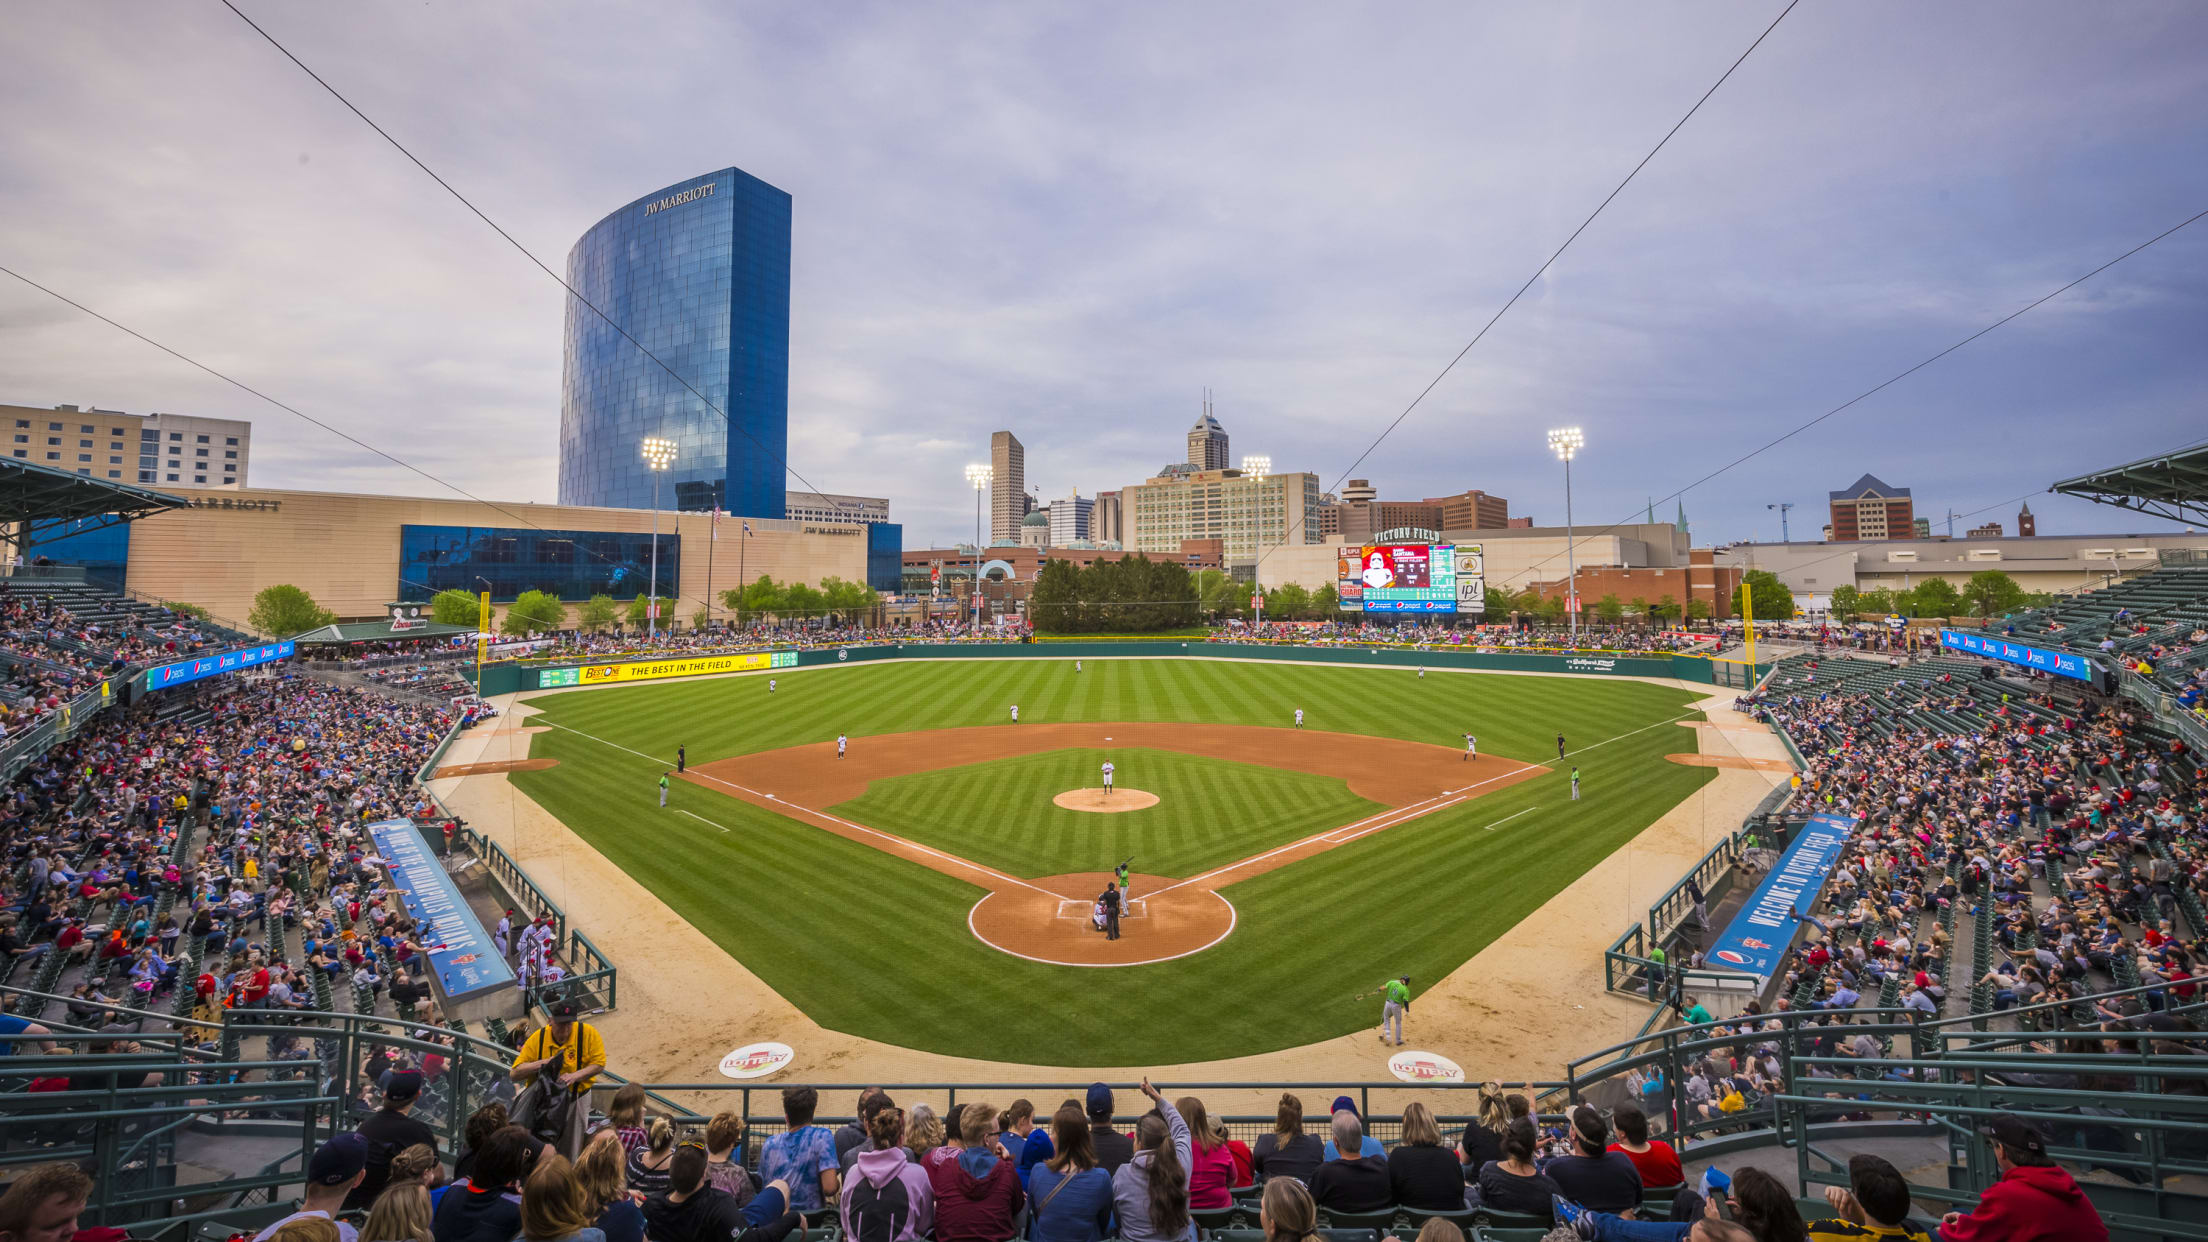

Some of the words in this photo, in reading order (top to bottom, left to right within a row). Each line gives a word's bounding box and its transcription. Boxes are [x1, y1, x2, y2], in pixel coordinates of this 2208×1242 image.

[644, 201, 660, 217] JW
[660, 183, 716, 211] MARRIOTT
[187, 497, 282, 512] ARRIOTT
[804, 526, 817, 534] JW
[818, 528, 862, 536] MARRIOTT
[1374, 528, 1410, 543] VICTORY
[1414, 528, 1440, 542] FIELD
[1340, 588, 1362, 596] GUARD
[1462, 582, 1478, 599] ipl
[631, 667, 649, 676] THE
[652, 664, 674, 674] BEST
[677, 664, 686, 672] IN
[689, 662, 705, 671] THE
[708, 661, 731, 669] FIELD
[1802, 832, 1835, 850] FIELD
[1784, 848, 1828, 876] VICTORY
[1776, 874, 1808, 887] TO
[405, 865, 455, 914] INDIANAPOLIS
[432, 912, 477, 951] INDIANS
[1747, 884, 1802, 928] WELCOME
[725, 1054, 788, 1068] LOTTERY
[1394, 1064, 1458, 1077] LOTTERY
